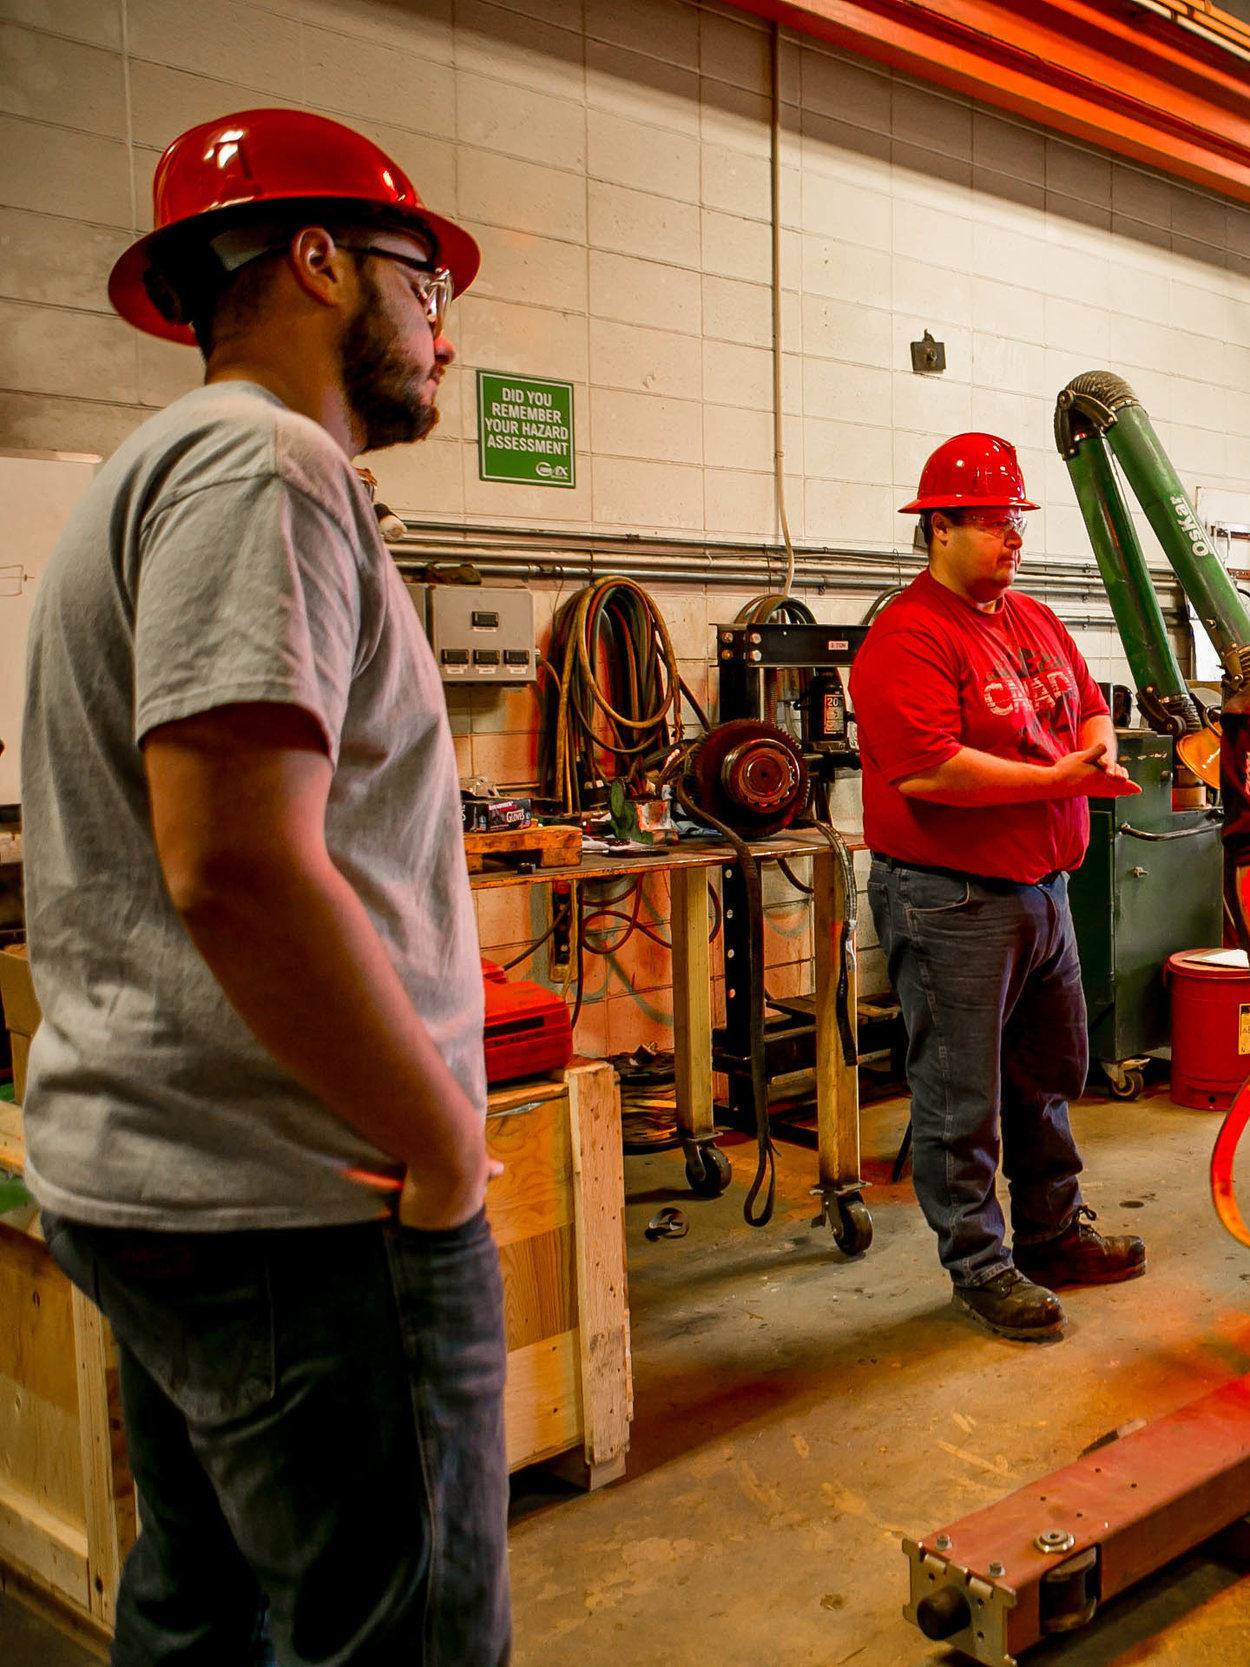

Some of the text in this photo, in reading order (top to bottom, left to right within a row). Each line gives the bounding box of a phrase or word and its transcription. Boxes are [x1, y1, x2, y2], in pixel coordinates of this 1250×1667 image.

[502, 387, 552, 407] DID YOU
[492, 402, 562, 424] REMEMBER
[485, 418, 569, 440] YOUR HAZARD
[487, 434, 568, 455] ASSESSMENT
[827, 697, 839, 707] 20
